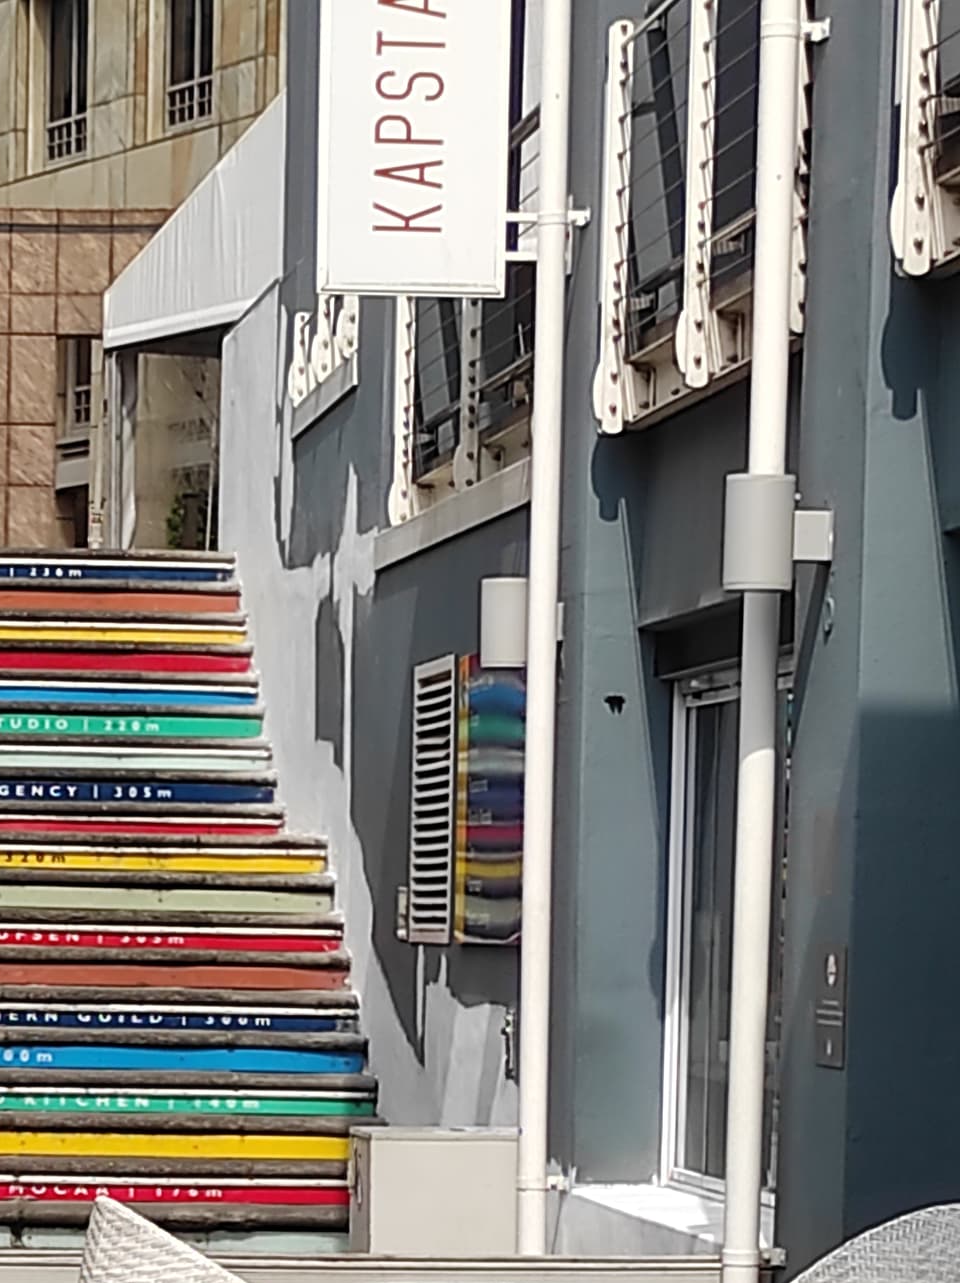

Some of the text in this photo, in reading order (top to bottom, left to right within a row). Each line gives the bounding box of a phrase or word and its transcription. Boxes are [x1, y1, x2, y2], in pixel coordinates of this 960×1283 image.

[114, 786, 173, 799] 305m
[77, 1013, 163, 1024] GUILD
[24, 1097, 150, 1107] KITCHEN
